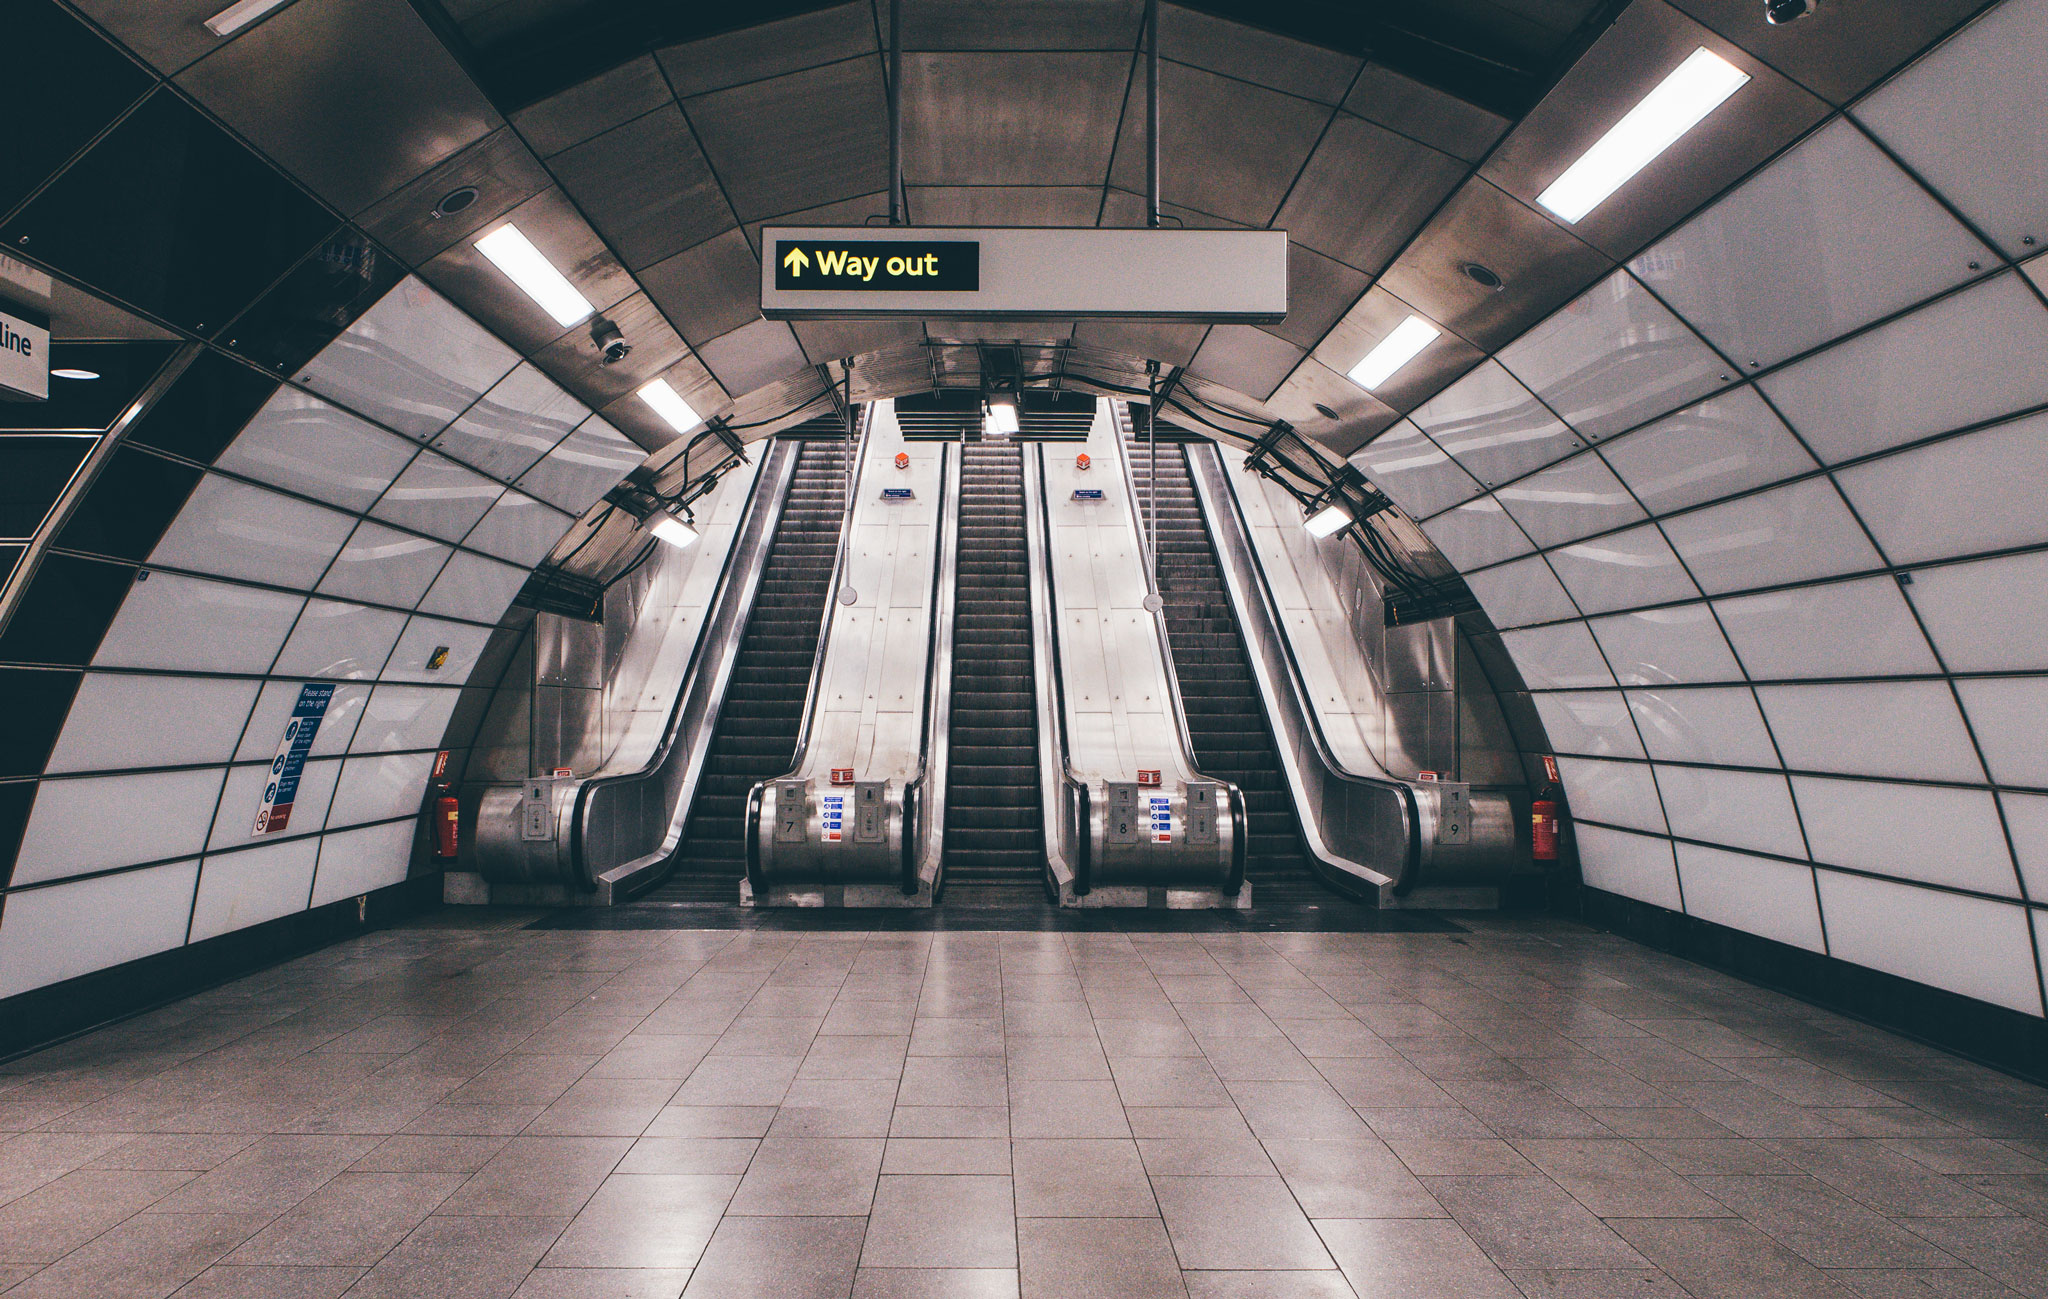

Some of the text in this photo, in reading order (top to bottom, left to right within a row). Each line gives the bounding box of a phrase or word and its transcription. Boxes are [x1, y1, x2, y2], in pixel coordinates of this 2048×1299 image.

[815, 250, 939, 282] Way out
[0, 321, 32, 356] line
[303, 688, 333, 697] Please stand
[298, 698, 327, 710] on the right
[786, 822, 794, 833] 7
[1120, 823, 1127, 834] 8
[1451, 824, 1459, 835] 9
